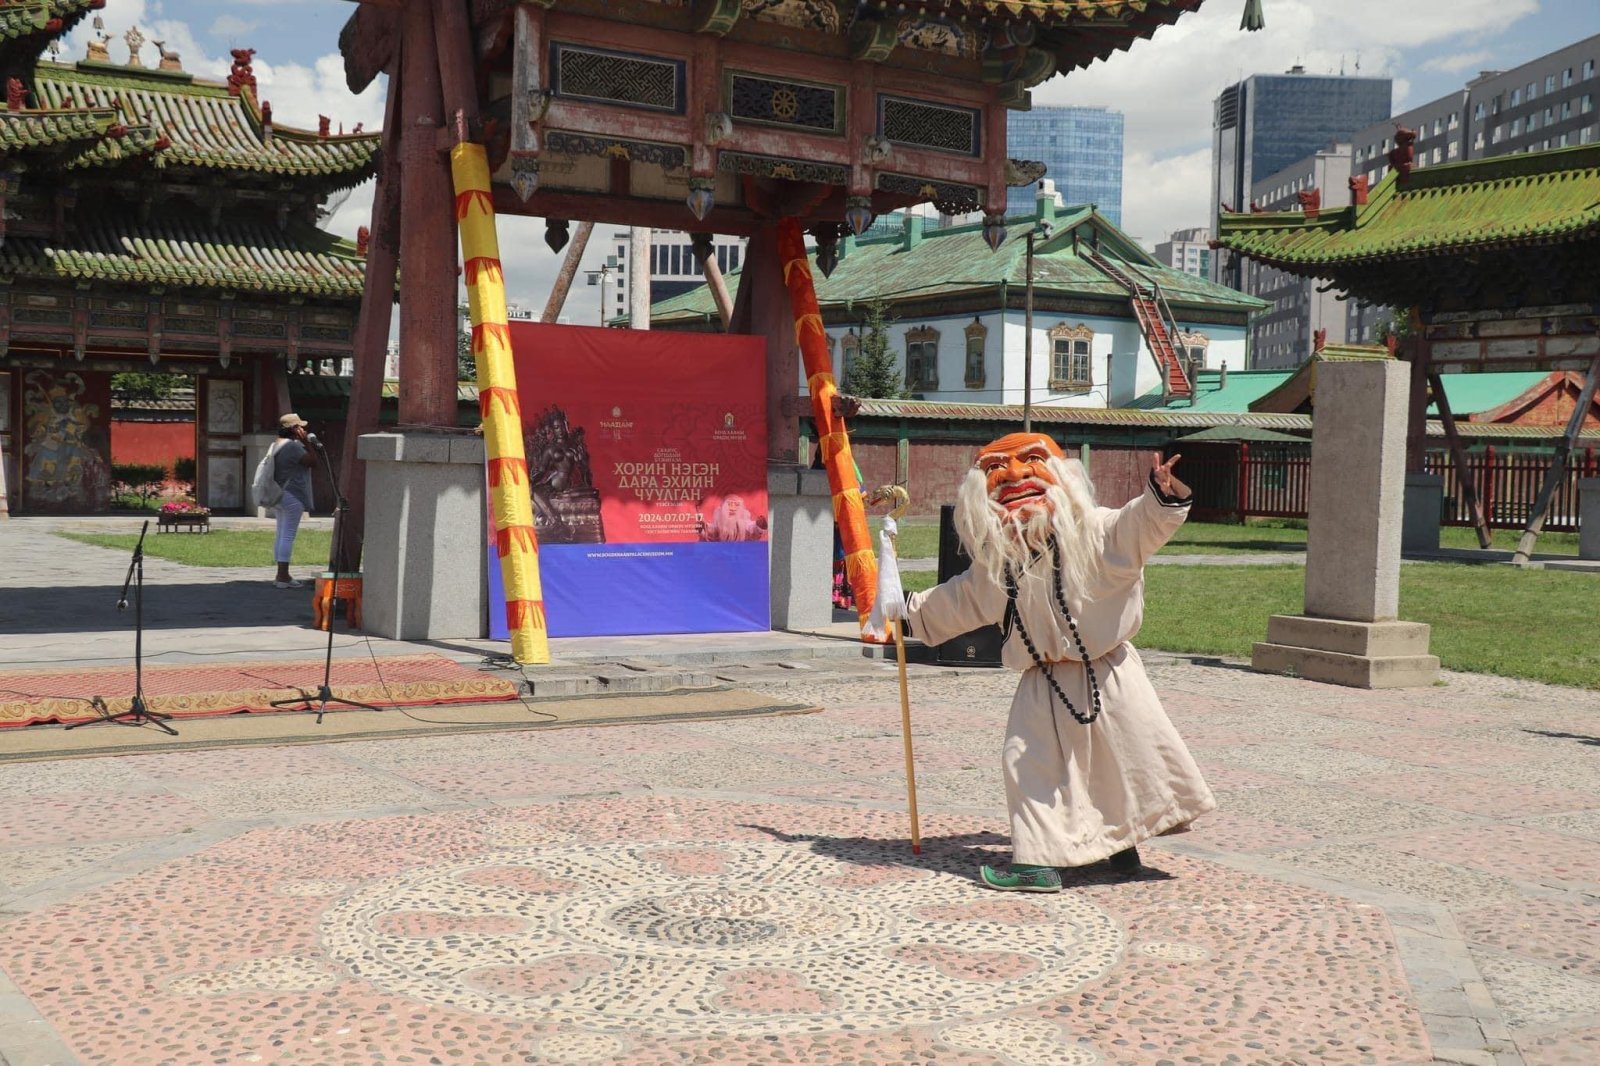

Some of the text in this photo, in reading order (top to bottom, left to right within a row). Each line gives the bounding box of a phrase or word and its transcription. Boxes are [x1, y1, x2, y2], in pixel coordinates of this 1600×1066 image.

[614, 462, 720, 476] ХОРИН НЭГЭН
[618, 475, 714, 489] ДАРА ЭХИЙН
[634, 488, 702, 501] ЧУУЛГАН
[638, 512, 704, 523] 2024.07.07-17
